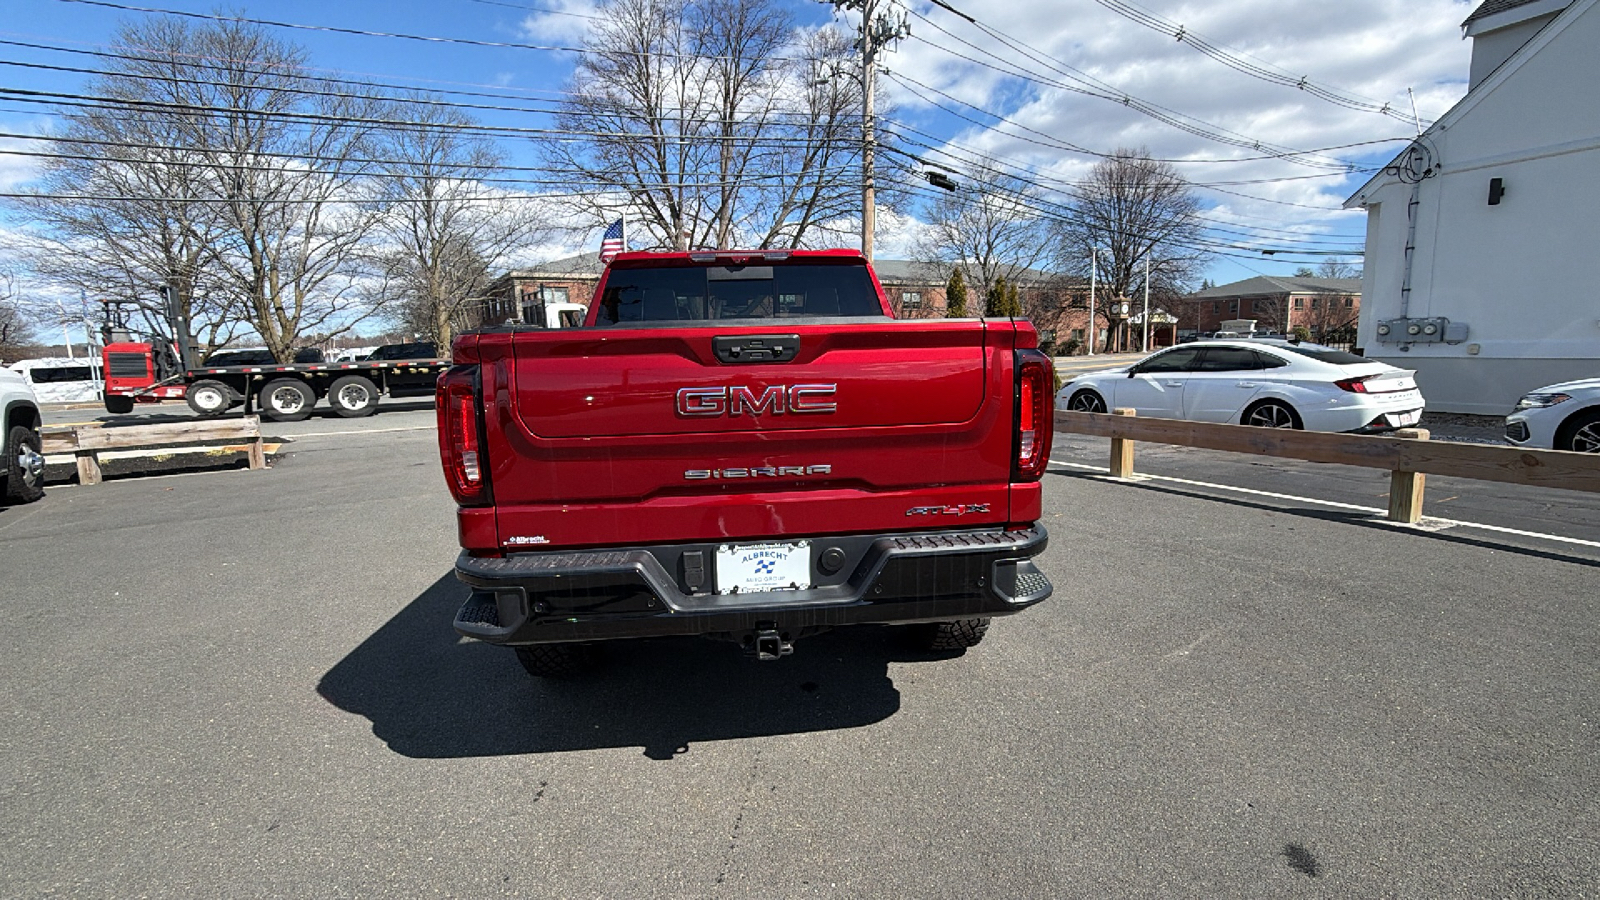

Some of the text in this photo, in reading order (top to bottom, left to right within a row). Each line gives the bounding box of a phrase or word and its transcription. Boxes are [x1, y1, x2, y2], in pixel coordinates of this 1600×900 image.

[677, 383, 837, 415] GMC
[684, 464, 832, 479] SIERRA
[906, 503, 991, 516] AT4X
[741, 551, 788, 563] ALBRECHT
